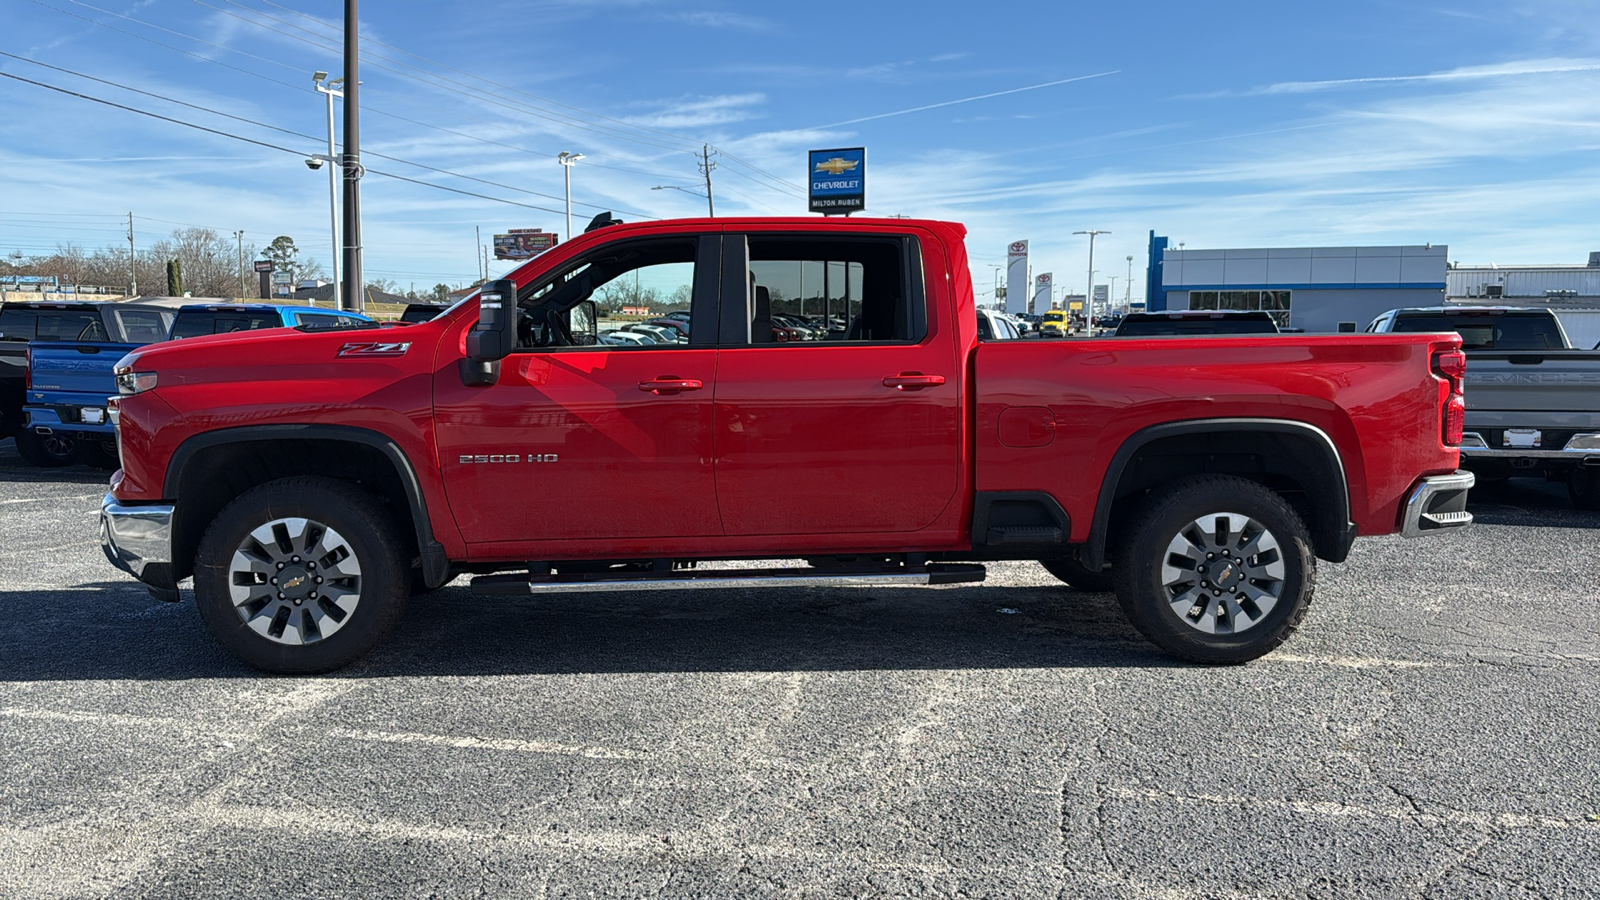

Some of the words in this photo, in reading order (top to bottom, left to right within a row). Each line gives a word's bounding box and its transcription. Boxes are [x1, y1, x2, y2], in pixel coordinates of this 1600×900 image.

[813, 180, 860, 190] CHEVROLET
[812, 199, 836, 207] MILTON
[838, 198, 861, 206] RUBEN
[338, 341, 412, 356] Z71
[459, 454, 520, 464] 2500
[528, 453, 558, 463] HD
